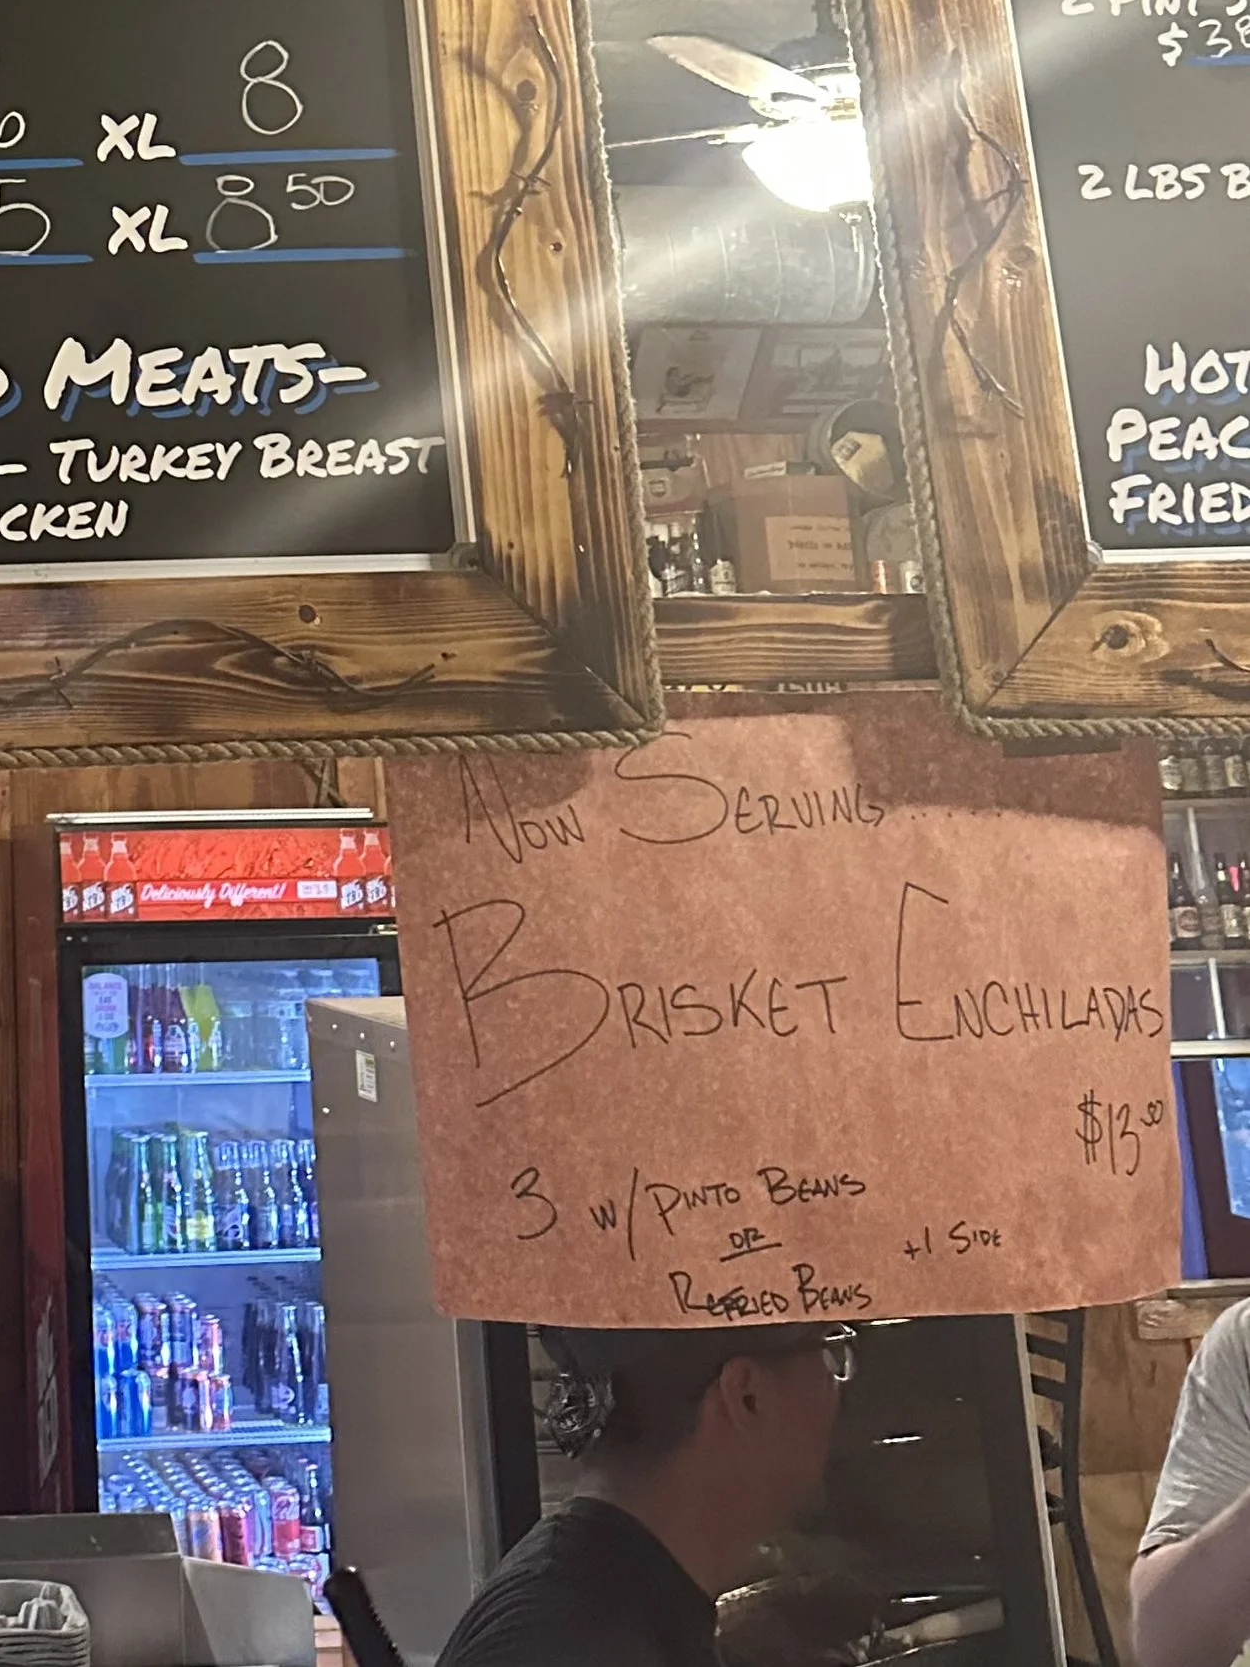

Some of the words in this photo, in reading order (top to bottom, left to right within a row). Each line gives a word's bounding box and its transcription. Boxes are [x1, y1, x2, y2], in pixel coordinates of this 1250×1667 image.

[97, 113, 176, 161] XL
[240, 40, 303, 134] 8
[1078, 165, 1111, 199] 2
[1125, 164, 1210, 199] LBS
[108, 205, 188, 254] XL
[50, 439, 242, 484] TURKEY
[253, 434, 445, 478] BREAST
[458, 749, 585, 866] NOW
[140, 882, 216, 909] Deliciously
[219, 880, 287, 907] Different!
[431, 898, 847, 1108] BRISKET
[895, 882, 1167, 1042] ENCHILADAS
[510, 1167, 558, 1240] 3
[758, 1166, 866, 1207] BEANS
[729, 1226, 763, 1251] OR
[950, 1222, 1004, 1252] SIDE
[791, 1263, 872, 1314] BEANS
